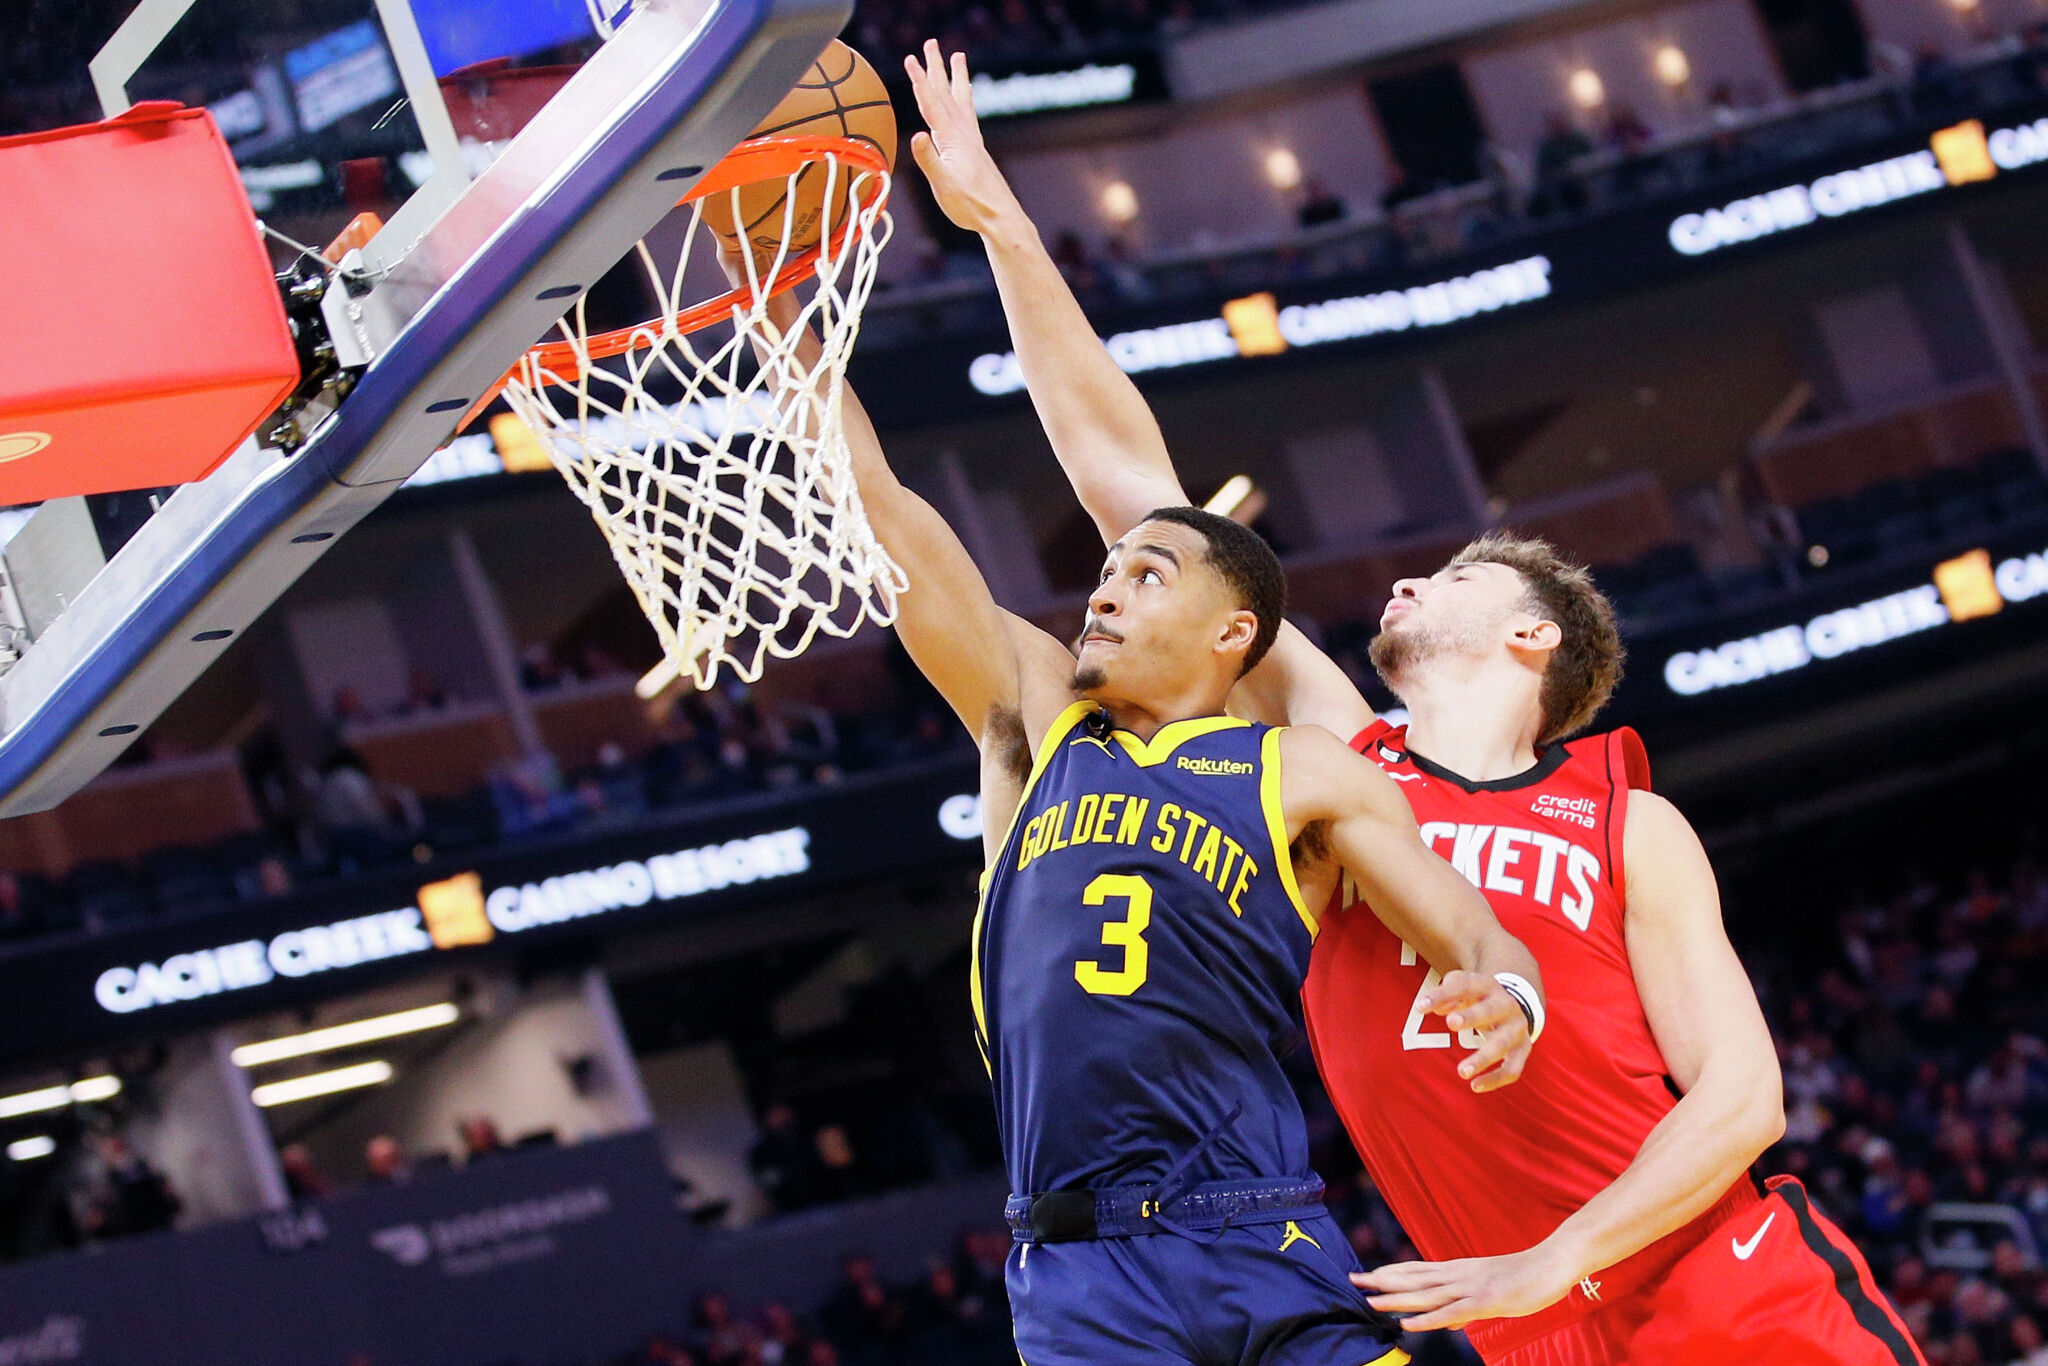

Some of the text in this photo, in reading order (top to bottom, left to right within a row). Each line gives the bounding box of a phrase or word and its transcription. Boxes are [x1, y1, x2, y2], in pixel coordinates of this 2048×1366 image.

[1176, 756, 1254, 776] Rakuten
[1537, 794, 1597, 815] credit
[1017, 793, 1150, 872] GOLDEN
[1150, 802, 1259, 918] STATE
[1341, 821, 1601, 932] CKETS
[1074, 873, 1154, 997] 3
